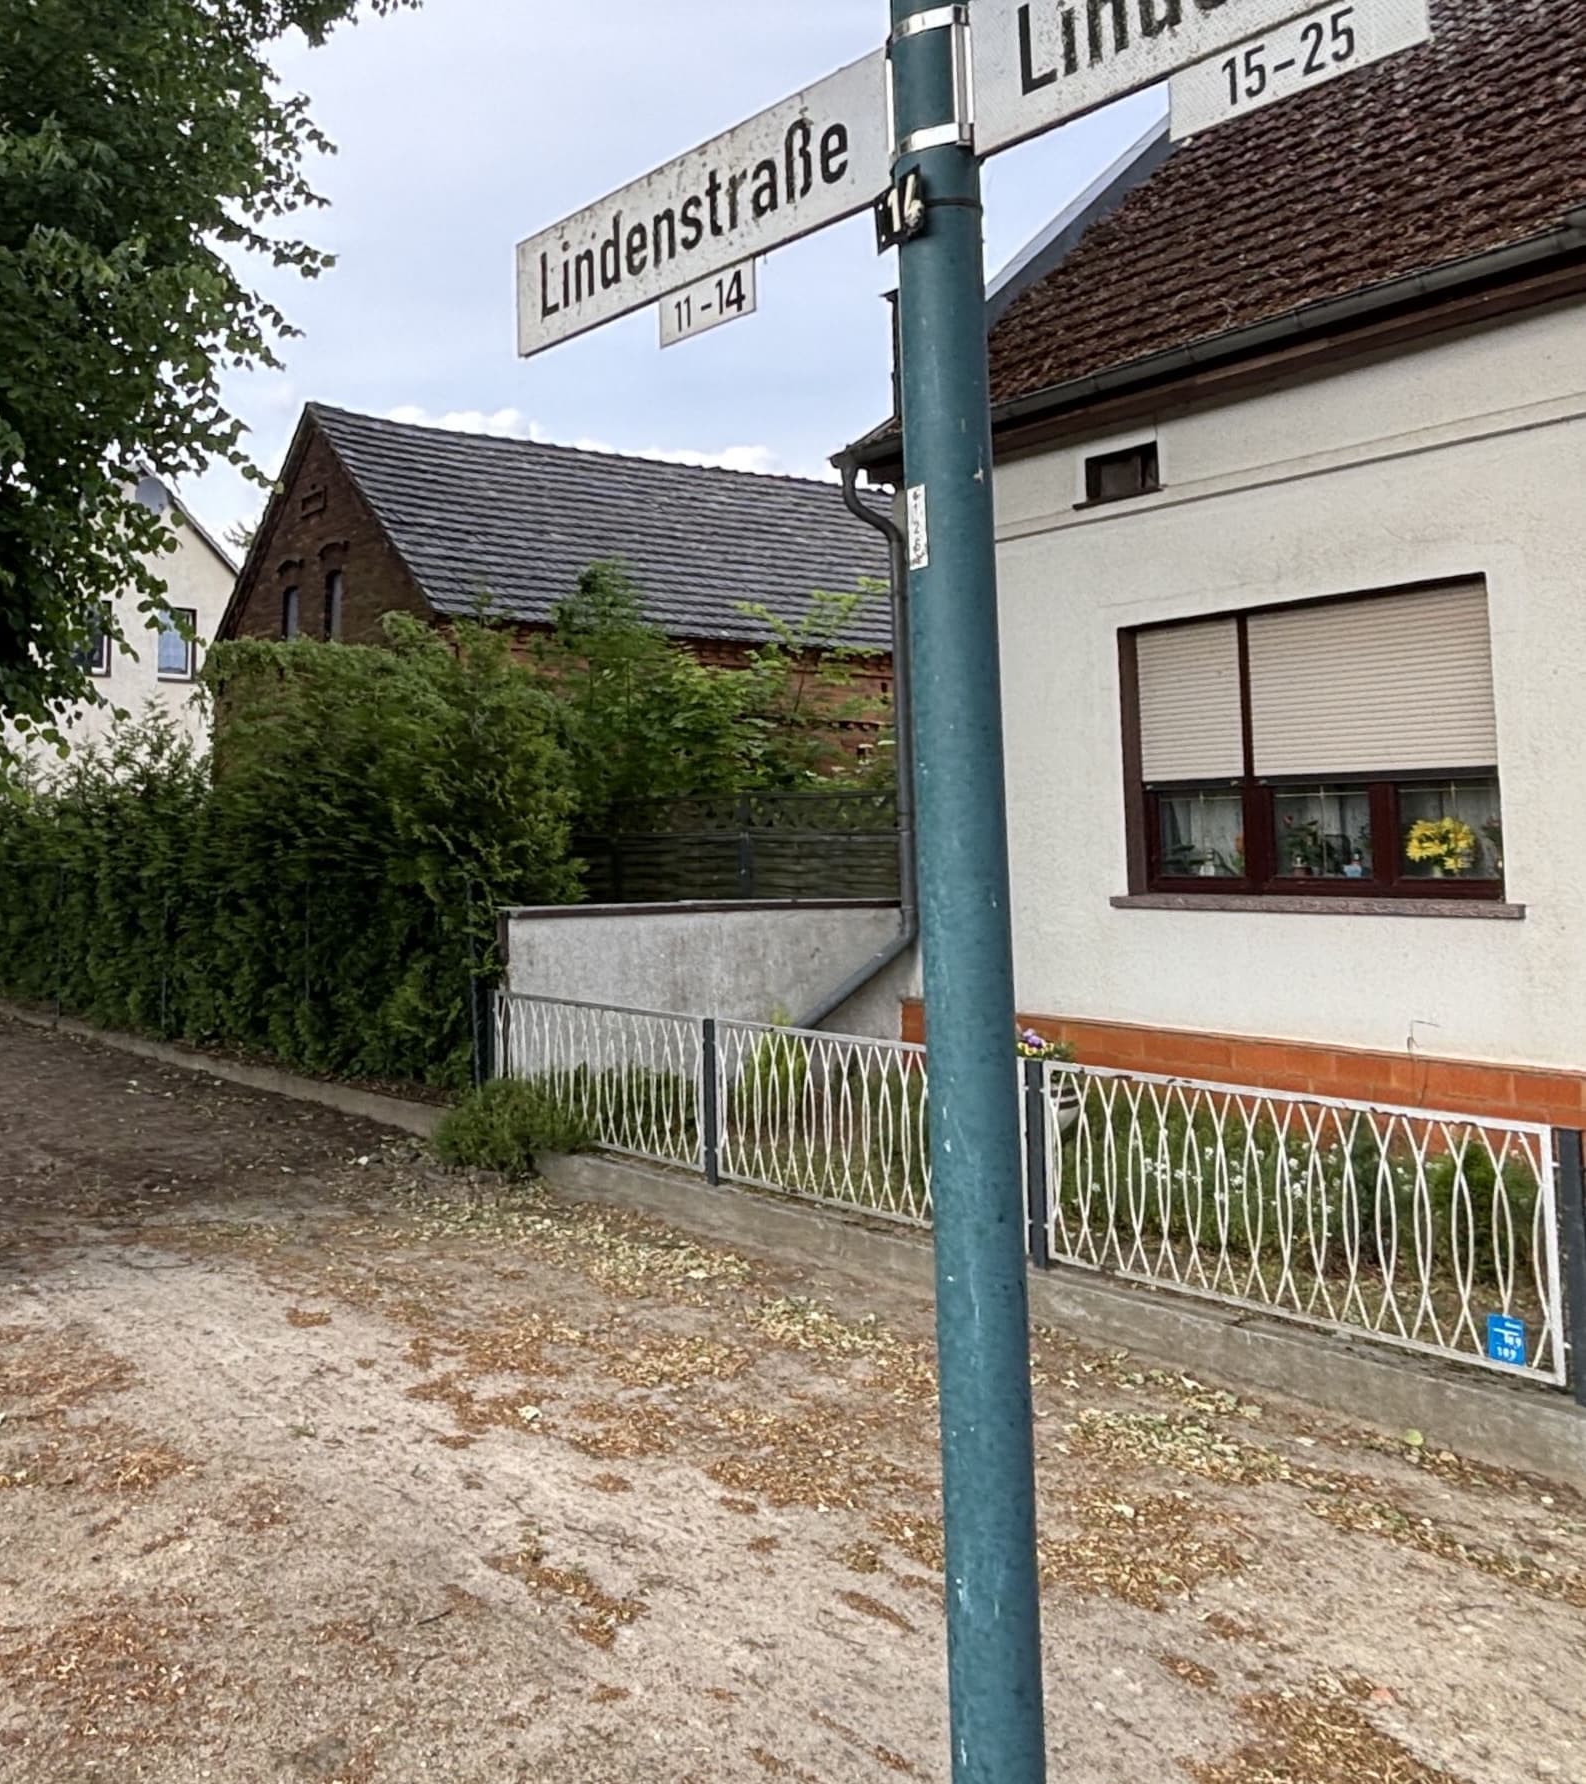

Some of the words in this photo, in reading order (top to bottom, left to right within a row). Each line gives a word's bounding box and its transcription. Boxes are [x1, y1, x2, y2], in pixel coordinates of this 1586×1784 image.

[1221, 6, 1356, 106] 15-25
[539, 118, 850, 319] Lindenstraße
[674, 269, 747, 333] 11-14
